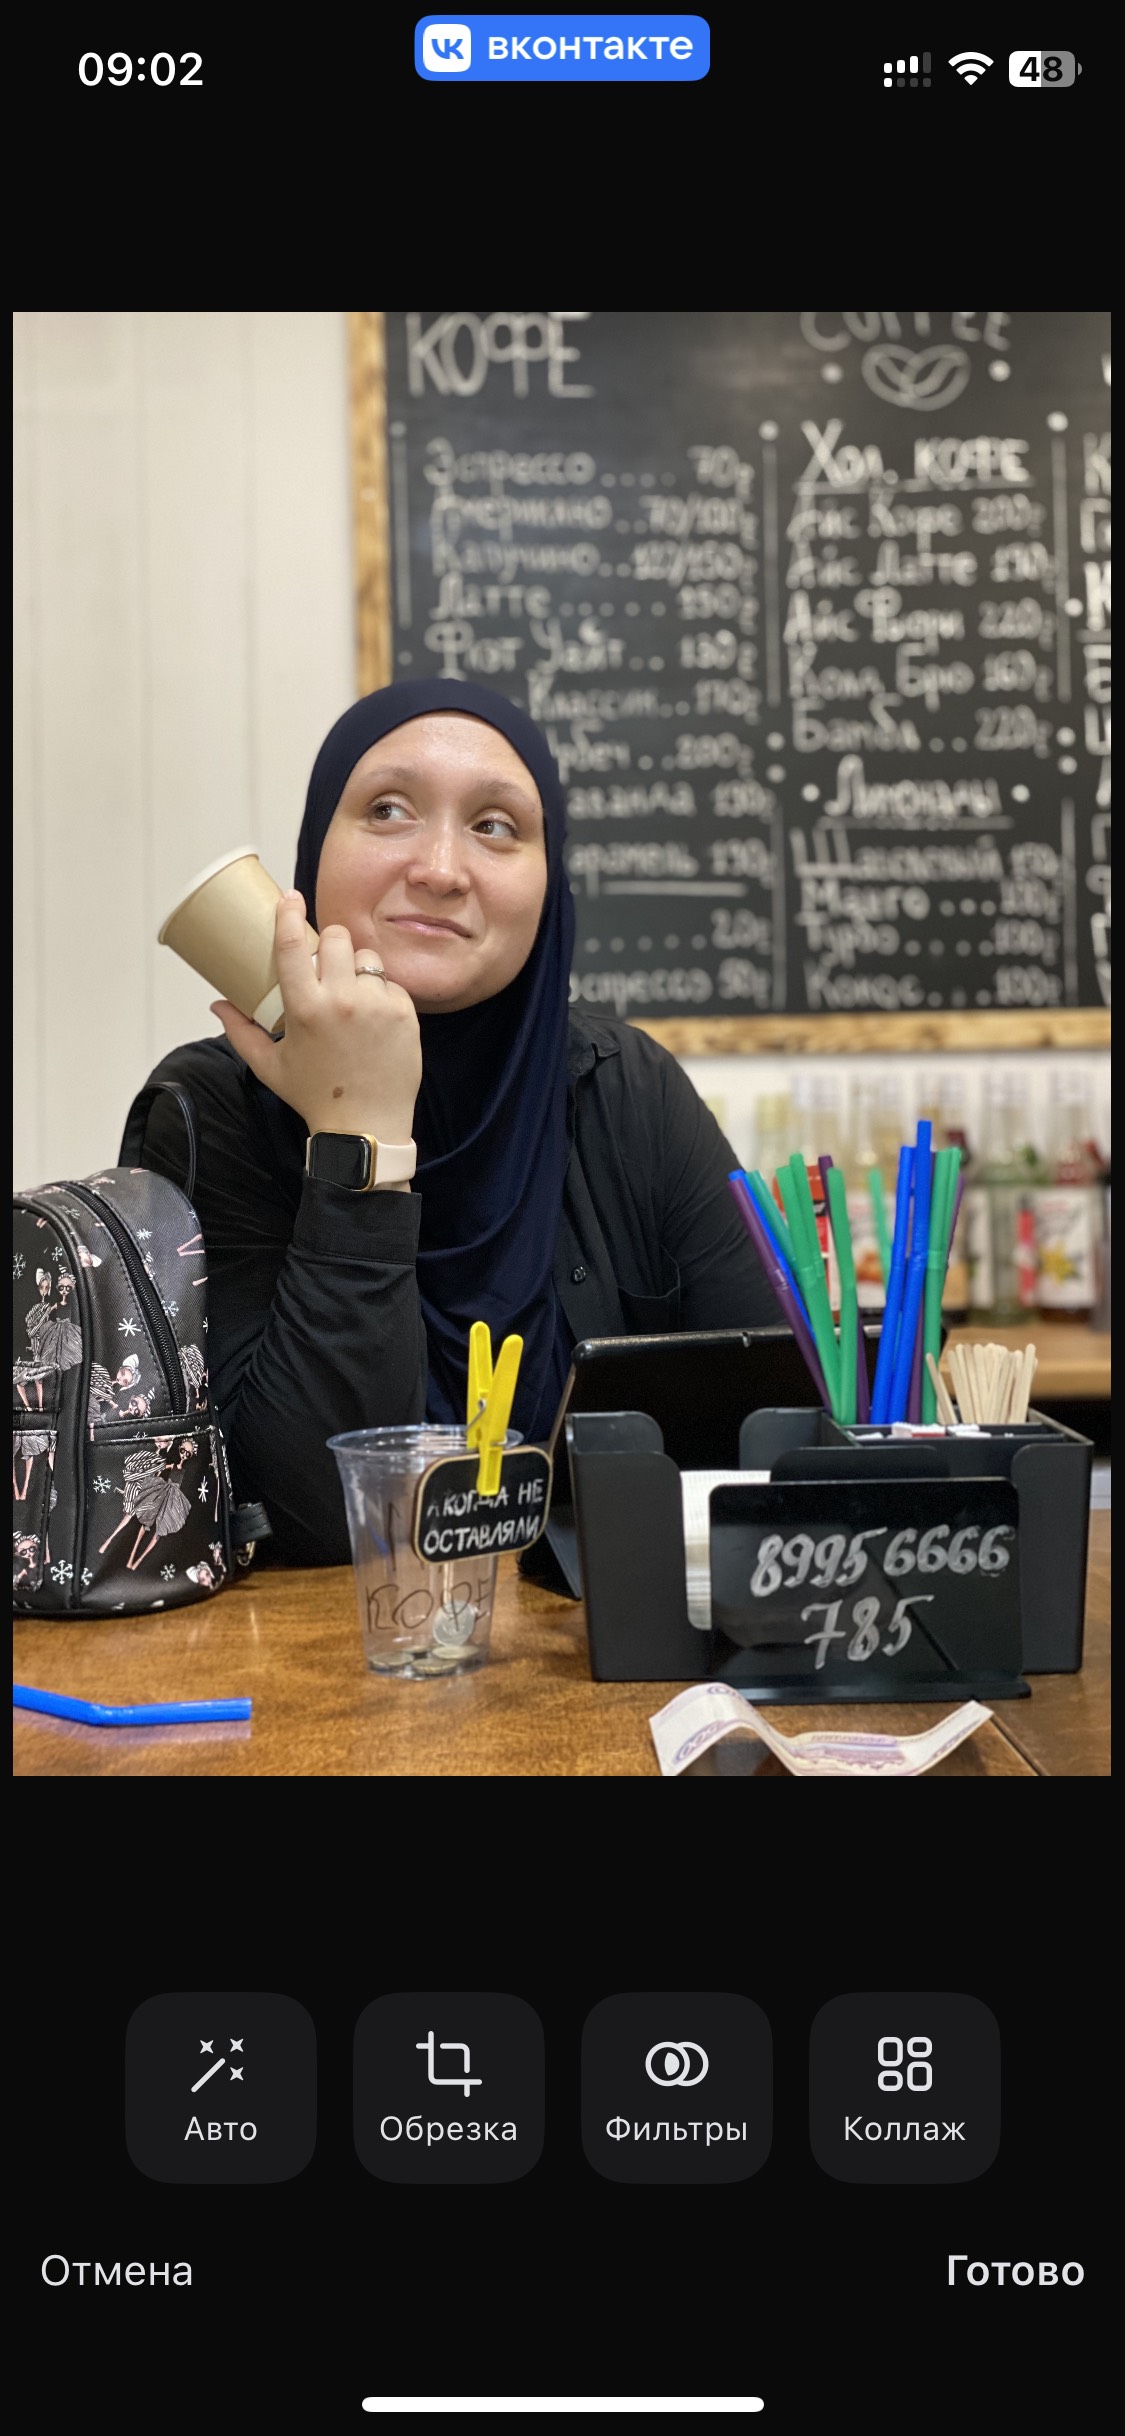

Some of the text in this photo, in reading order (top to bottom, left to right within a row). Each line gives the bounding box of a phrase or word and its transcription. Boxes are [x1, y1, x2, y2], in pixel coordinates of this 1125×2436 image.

[406, 312, 594, 397] КОФЕ
[424, 437, 596, 496] Эспрессо
[914, 436, 1030, 485] КОФЕ
[430, 487, 613, 541] Американо
[432, 541, 599, 583] Капучино
[786, 541, 862, 590] Айс
[870, 539, 978, 587] Латте
[430, 572, 552, 620] Латте
[783, 589, 860, 644] Айс
[896, 641, 975, 713] Брю
[823, 753, 1002, 819] Лимонады
[803, 958, 925, 1010] Кокос
[518, 1478, 544, 1505] НЕ
[423, 1515, 541, 1556] ОСТАВЛЯЛИ
[366, 1578, 491, 1634] КОФЕ
[801, 1595, 935, 1670] 785
